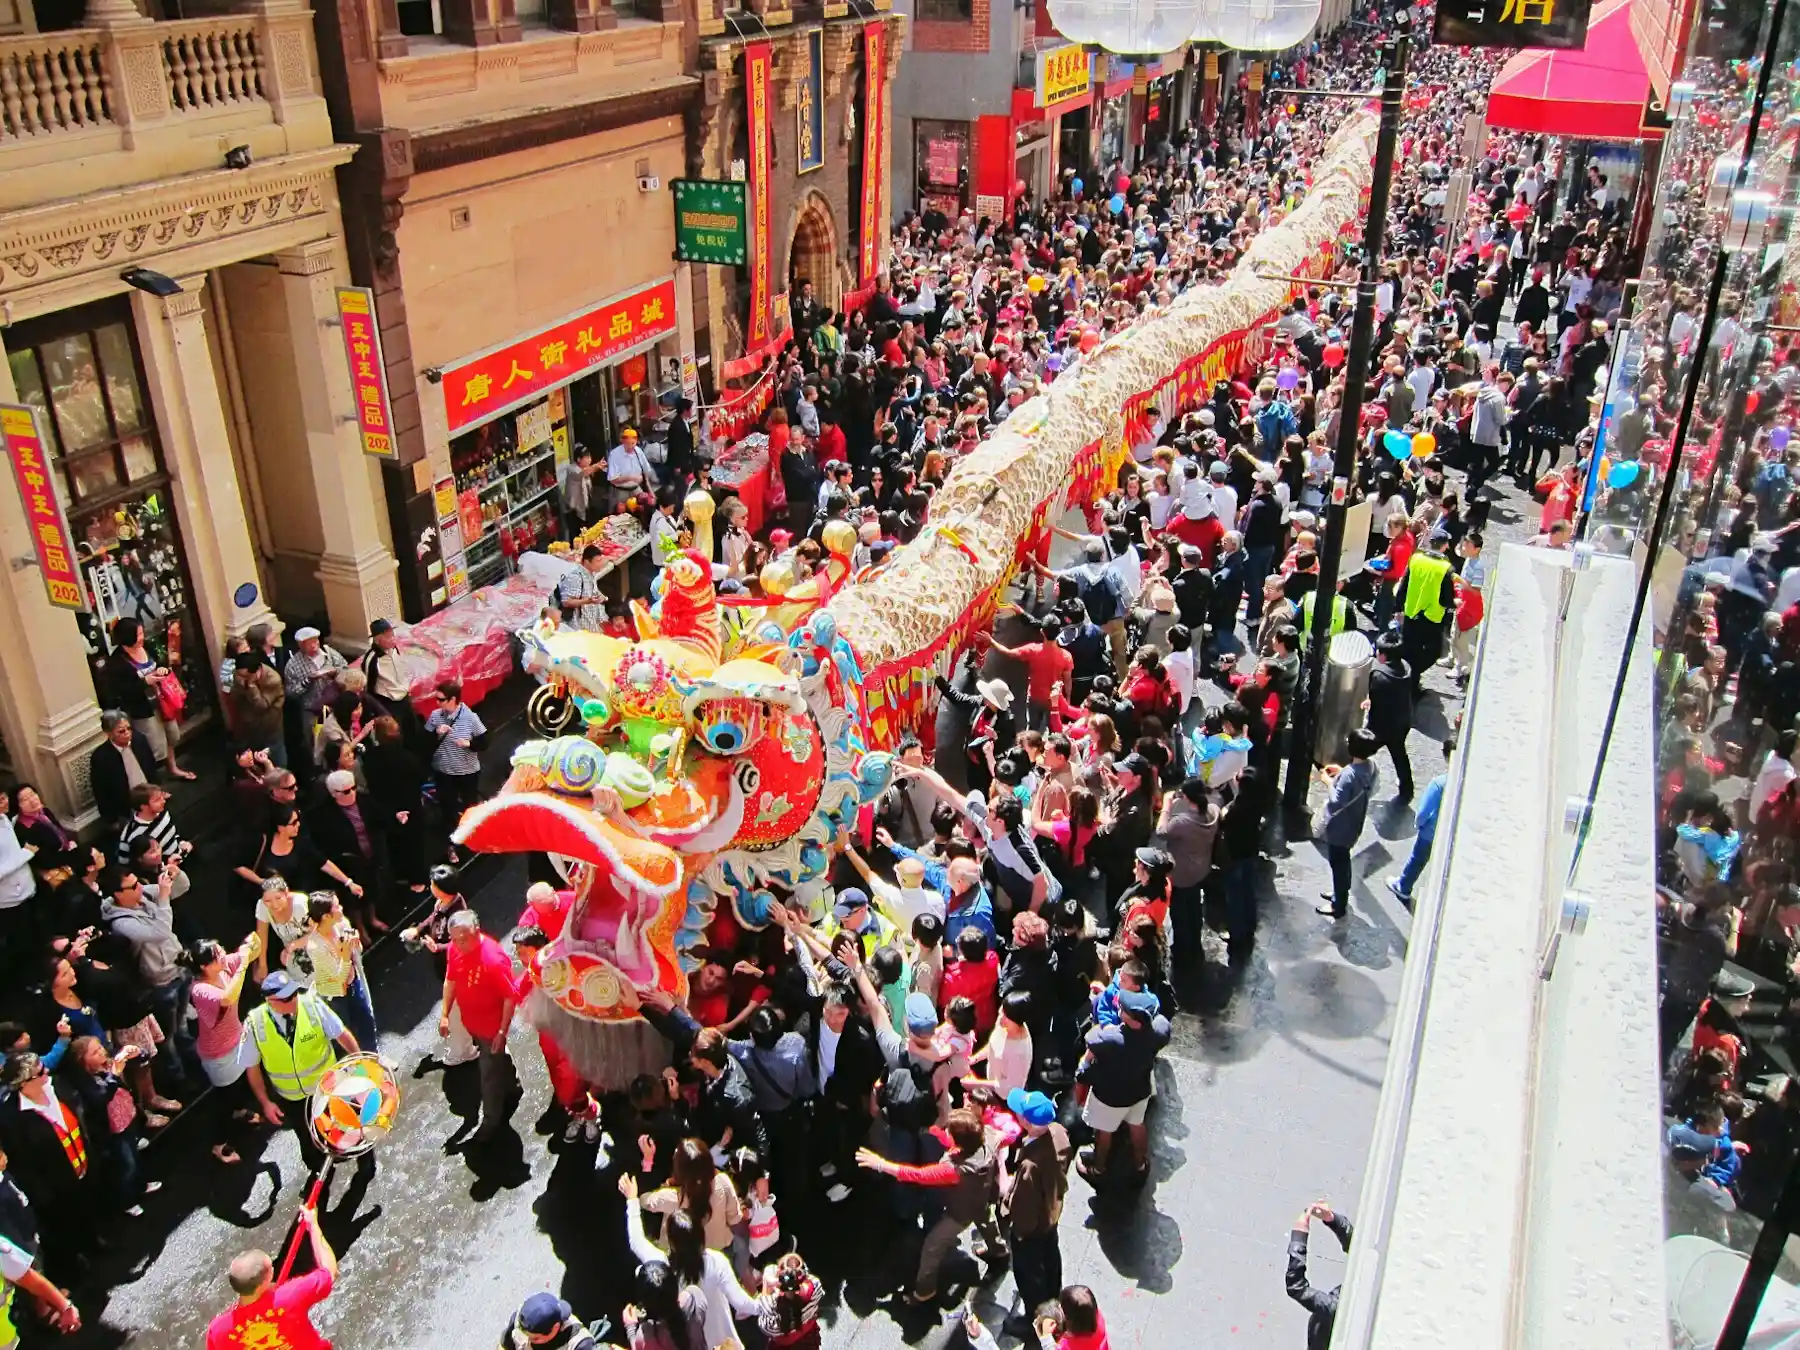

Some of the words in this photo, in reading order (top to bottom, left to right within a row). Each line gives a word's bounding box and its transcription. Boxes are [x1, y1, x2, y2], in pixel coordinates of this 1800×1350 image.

[461, 297, 665, 406] 唐人街礼品城
[368, 436, 390, 450] 202
[53, 583, 79, 602] 202
